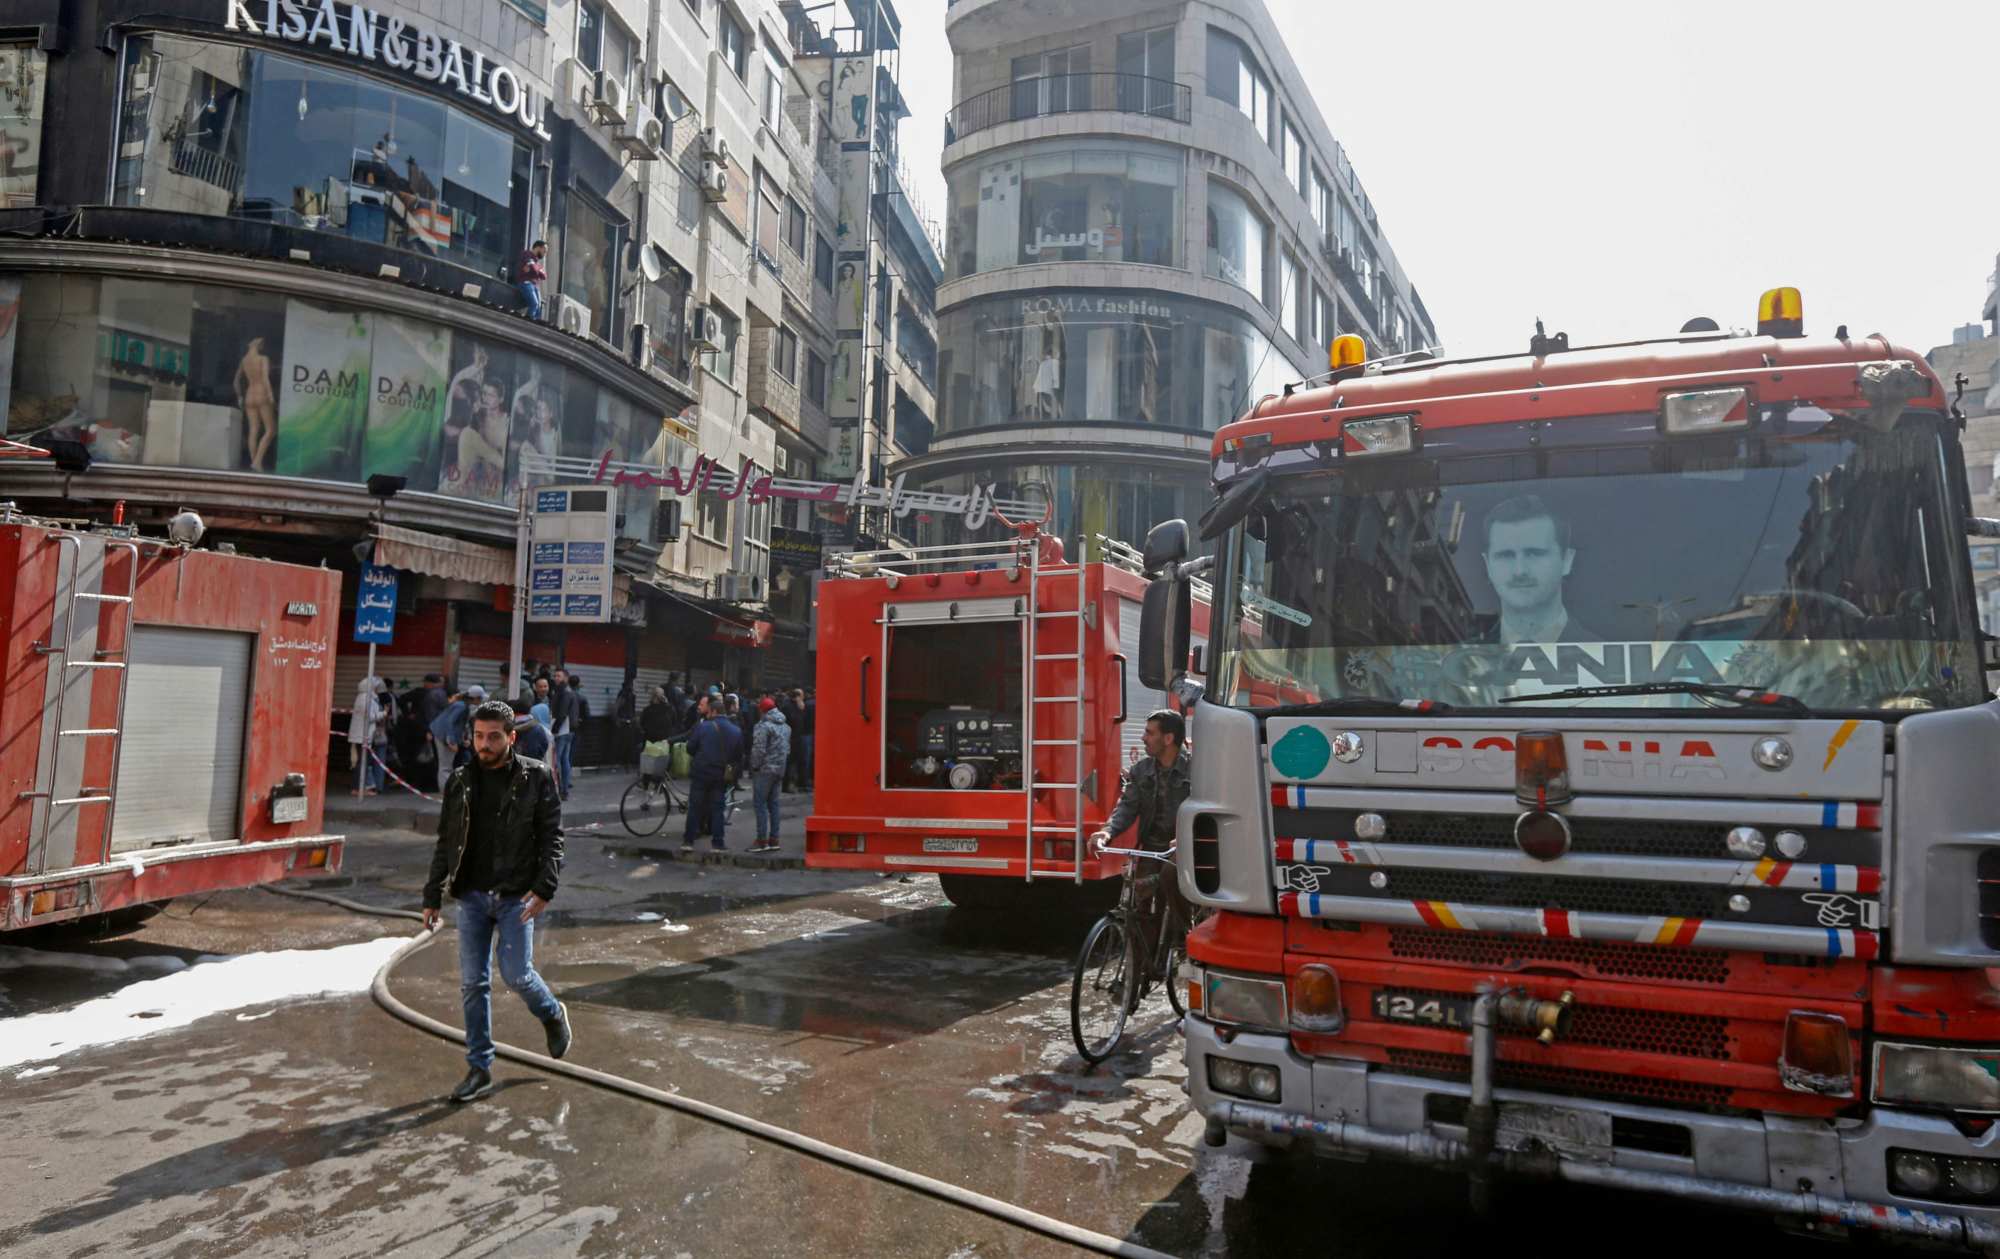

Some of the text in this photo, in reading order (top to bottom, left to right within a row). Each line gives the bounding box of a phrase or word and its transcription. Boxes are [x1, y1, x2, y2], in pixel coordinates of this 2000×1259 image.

[1021, 297, 1171, 318] ROMA fashion
[293, 365, 359, 389] DAM
[377, 376, 437, 402] DAM
[364, 569, 395, 588] الوقوف
[360, 593, 393, 613] بشكل
[1420, 736, 1728, 779] SCNIA
